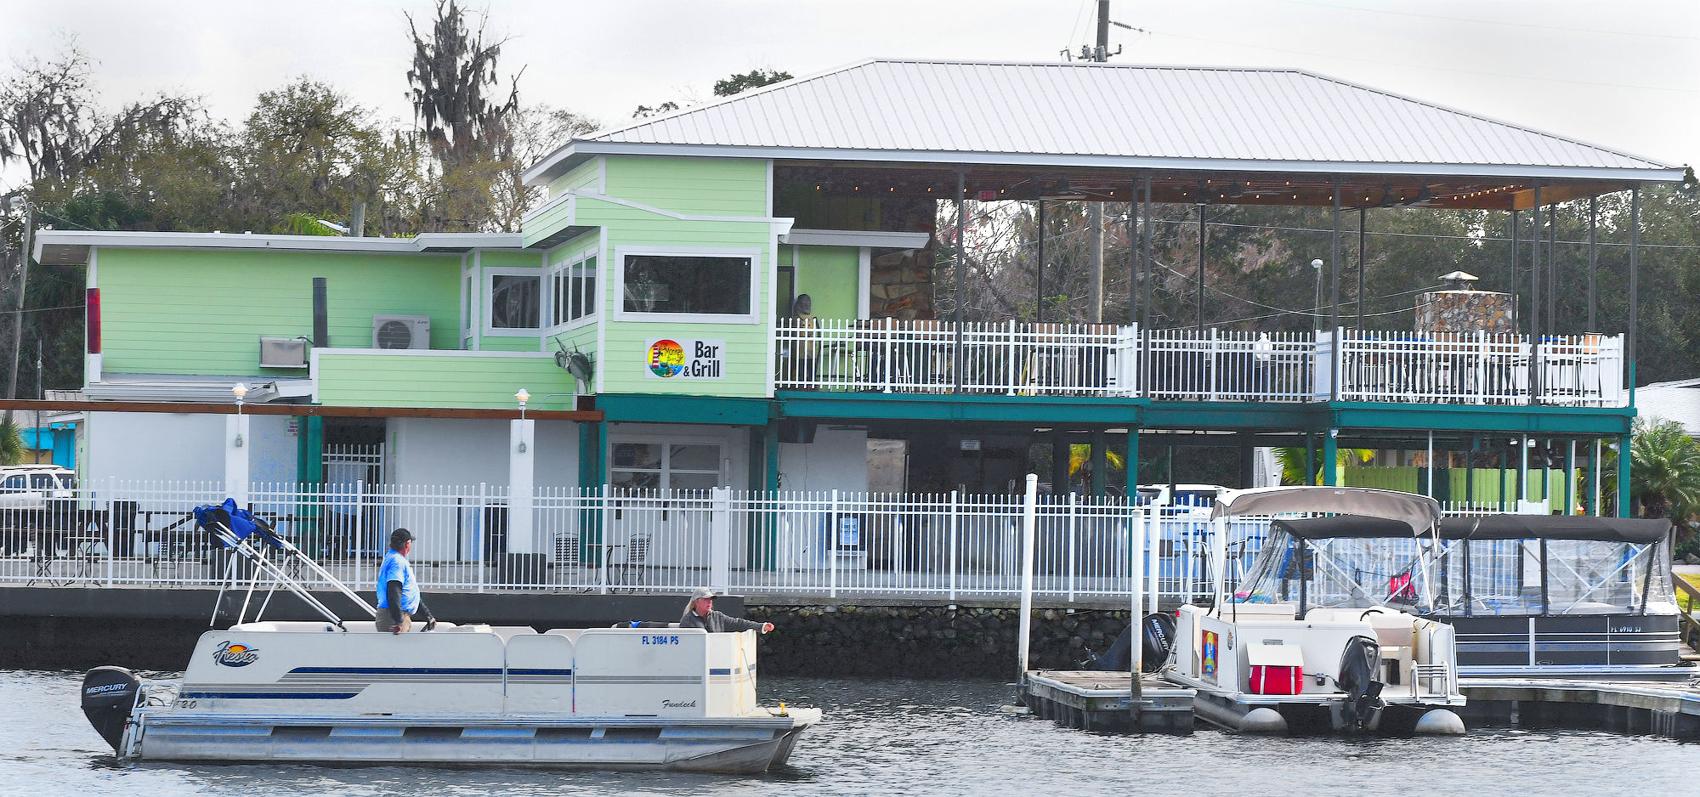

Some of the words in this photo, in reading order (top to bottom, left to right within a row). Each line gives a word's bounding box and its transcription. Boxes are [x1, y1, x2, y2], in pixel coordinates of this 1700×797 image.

[695, 341, 718, 358] Bar
[683, 366, 690, 377] &
[692, 360, 720, 377] Grill
[642, 636, 649, 645] FL
[652, 636, 667, 645] 3184
[670, 636, 679, 645] PS
[213, 641, 259, 665] Fiesta
[86, 683, 128, 694] MERCURY
